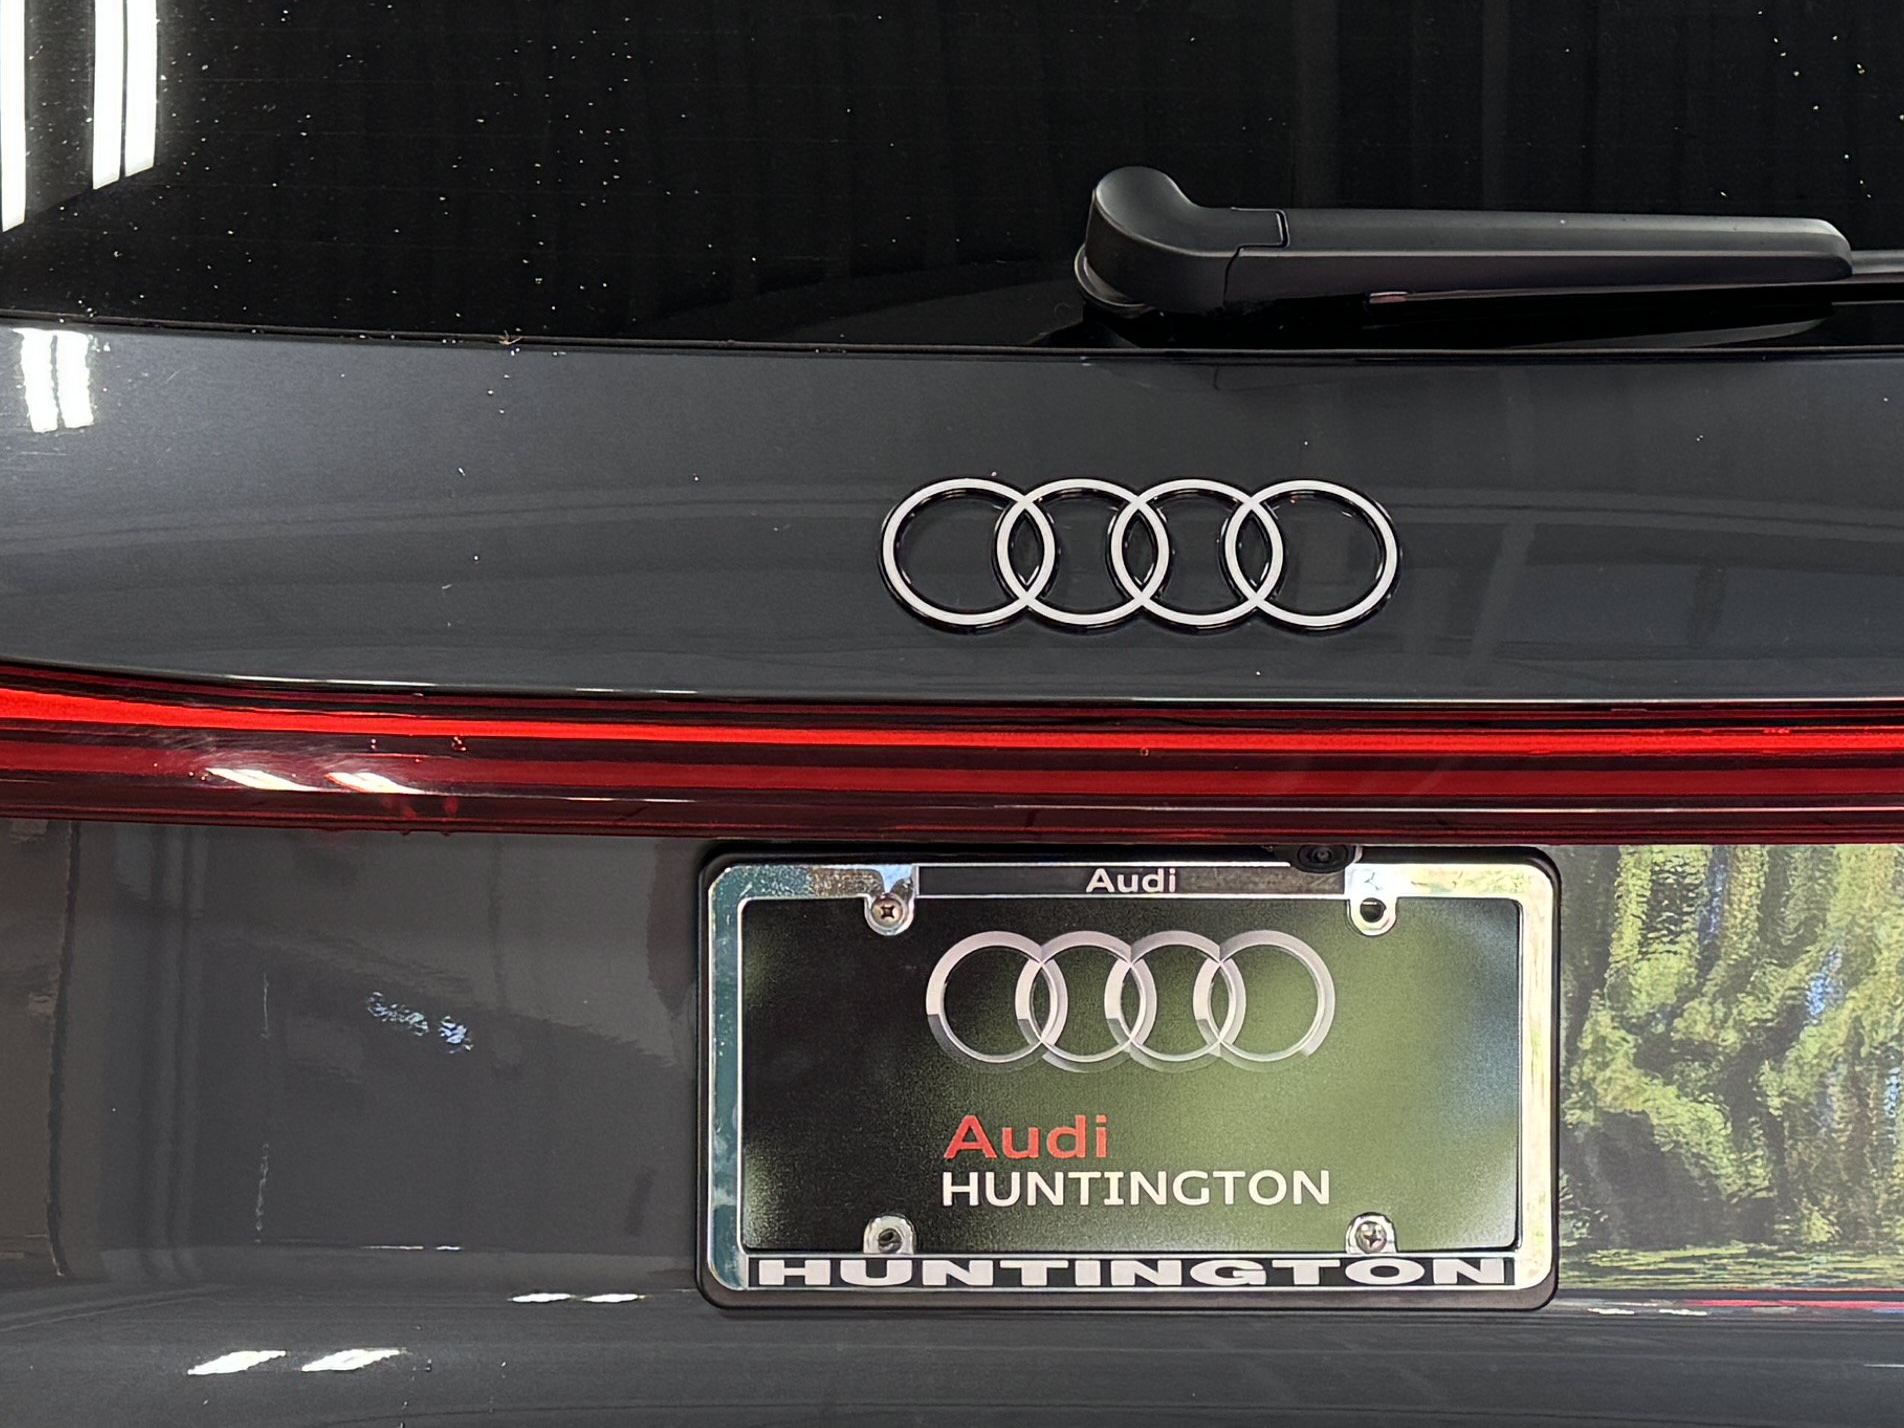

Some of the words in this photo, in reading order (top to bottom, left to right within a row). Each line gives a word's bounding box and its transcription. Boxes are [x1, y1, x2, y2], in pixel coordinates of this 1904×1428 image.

[1085, 868, 1176, 893] Audi
[943, 1115, 1108, 1159] Audi
[942, 1169, 1330, 1207] HUNTINGTON
[758, 1258, 1505, 1287] HUNTINGTON
